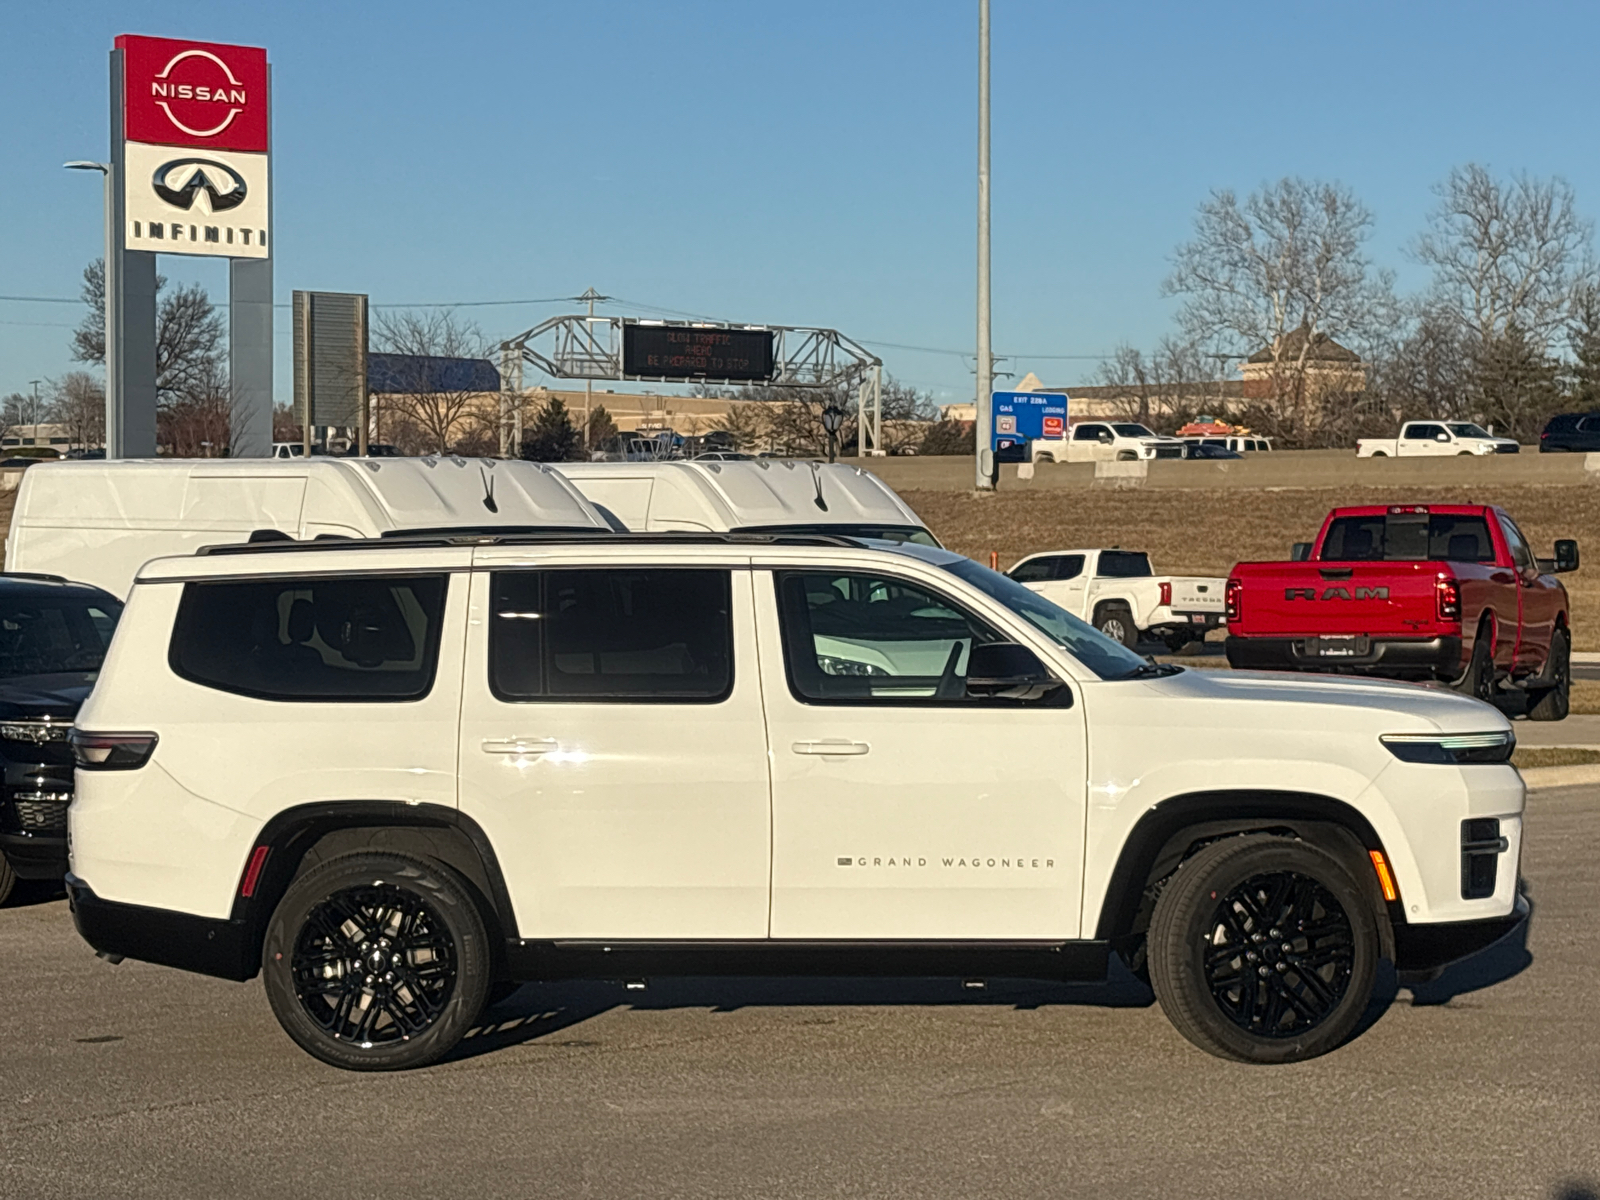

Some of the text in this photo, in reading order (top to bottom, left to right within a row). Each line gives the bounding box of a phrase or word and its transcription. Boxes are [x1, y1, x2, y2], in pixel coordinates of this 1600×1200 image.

[151, 82, 246, 104] NISSAN
[132, 220, 266, 246] INFINITI
[667, 332, 731, 345] SLOW TRAFFIC
[685, 345, 712, 356] AHEAD
[647, 355, 750, 369] BE PREPARED TO STOP
[1284, 587, 1390, 601] RAM
[858, 857, 1055, 868] GRAND WAGONEER
